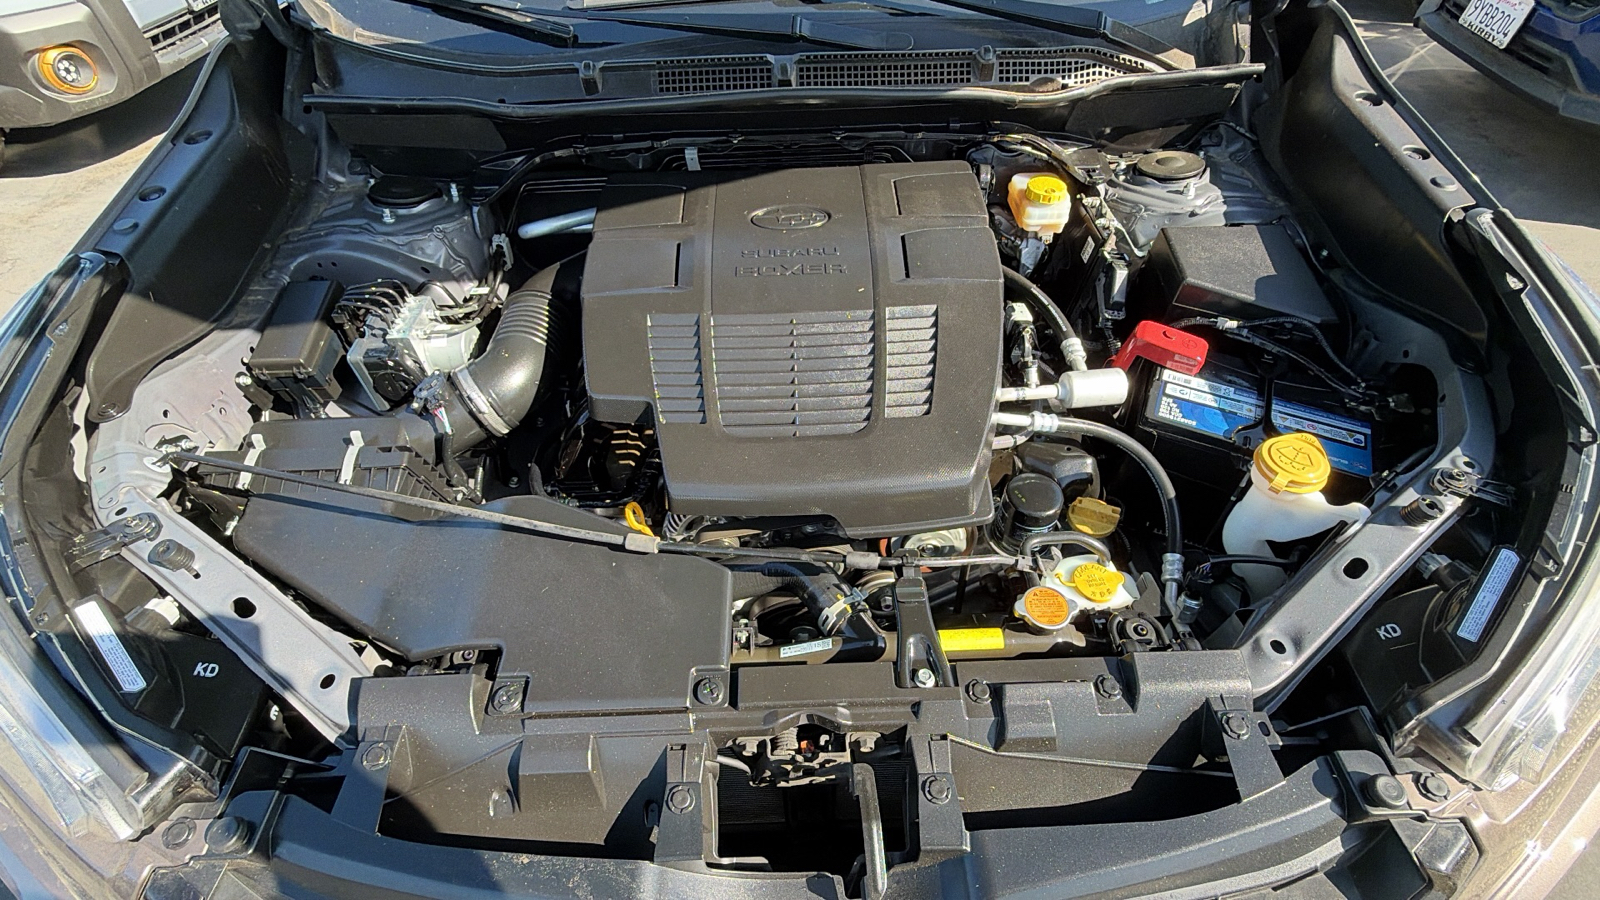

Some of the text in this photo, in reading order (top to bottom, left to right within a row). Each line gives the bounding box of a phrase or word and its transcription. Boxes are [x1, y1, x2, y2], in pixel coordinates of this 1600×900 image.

[1468, 0, 1516, 38] 9YBB204
[1467, 21, 1498, 42] KIRBY
[741, 246, 840, 259] SUBARU
[734, 263, 848, 277] BOXER
[1375, 623, 1402, 640] KD
[193, 662, 219, 678] KD
